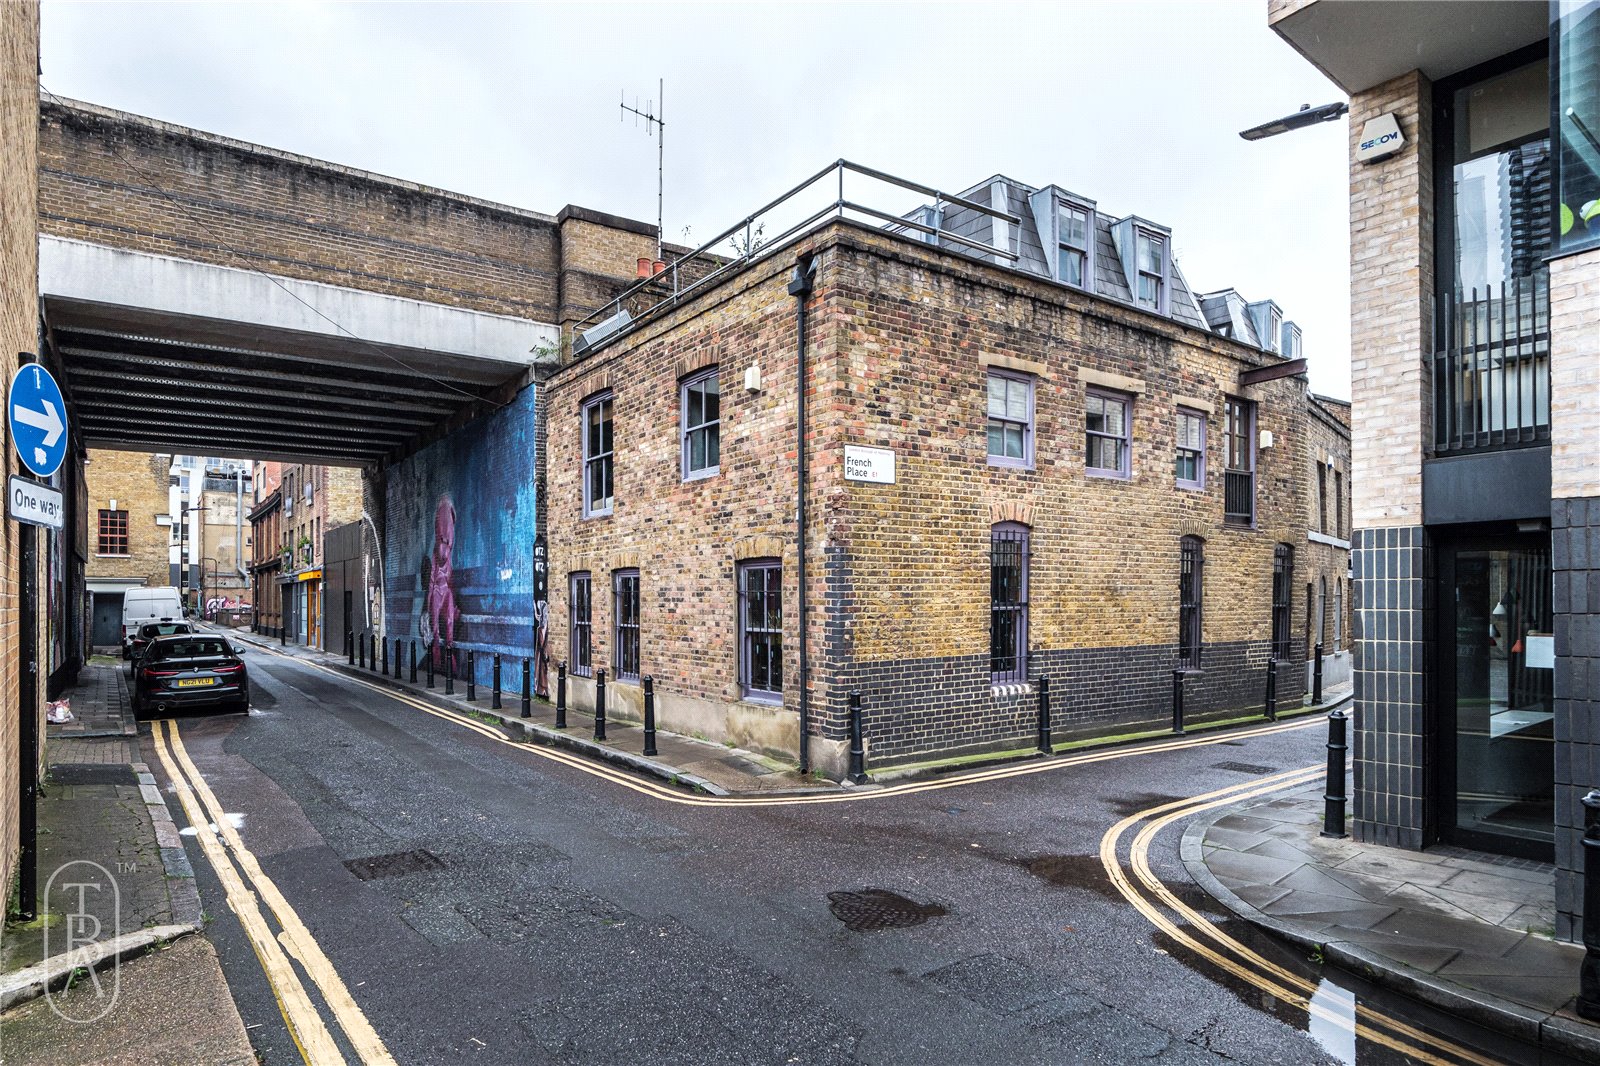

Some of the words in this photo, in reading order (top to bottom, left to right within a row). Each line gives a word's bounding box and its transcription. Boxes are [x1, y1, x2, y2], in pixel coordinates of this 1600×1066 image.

[1361, 131, 1398, 151] SECOM
[846, 456, 872, 468] French
[846, 466, 868, 478] Place
[15, 488, 37, 510] One
[40, 499, 60, 519] way
